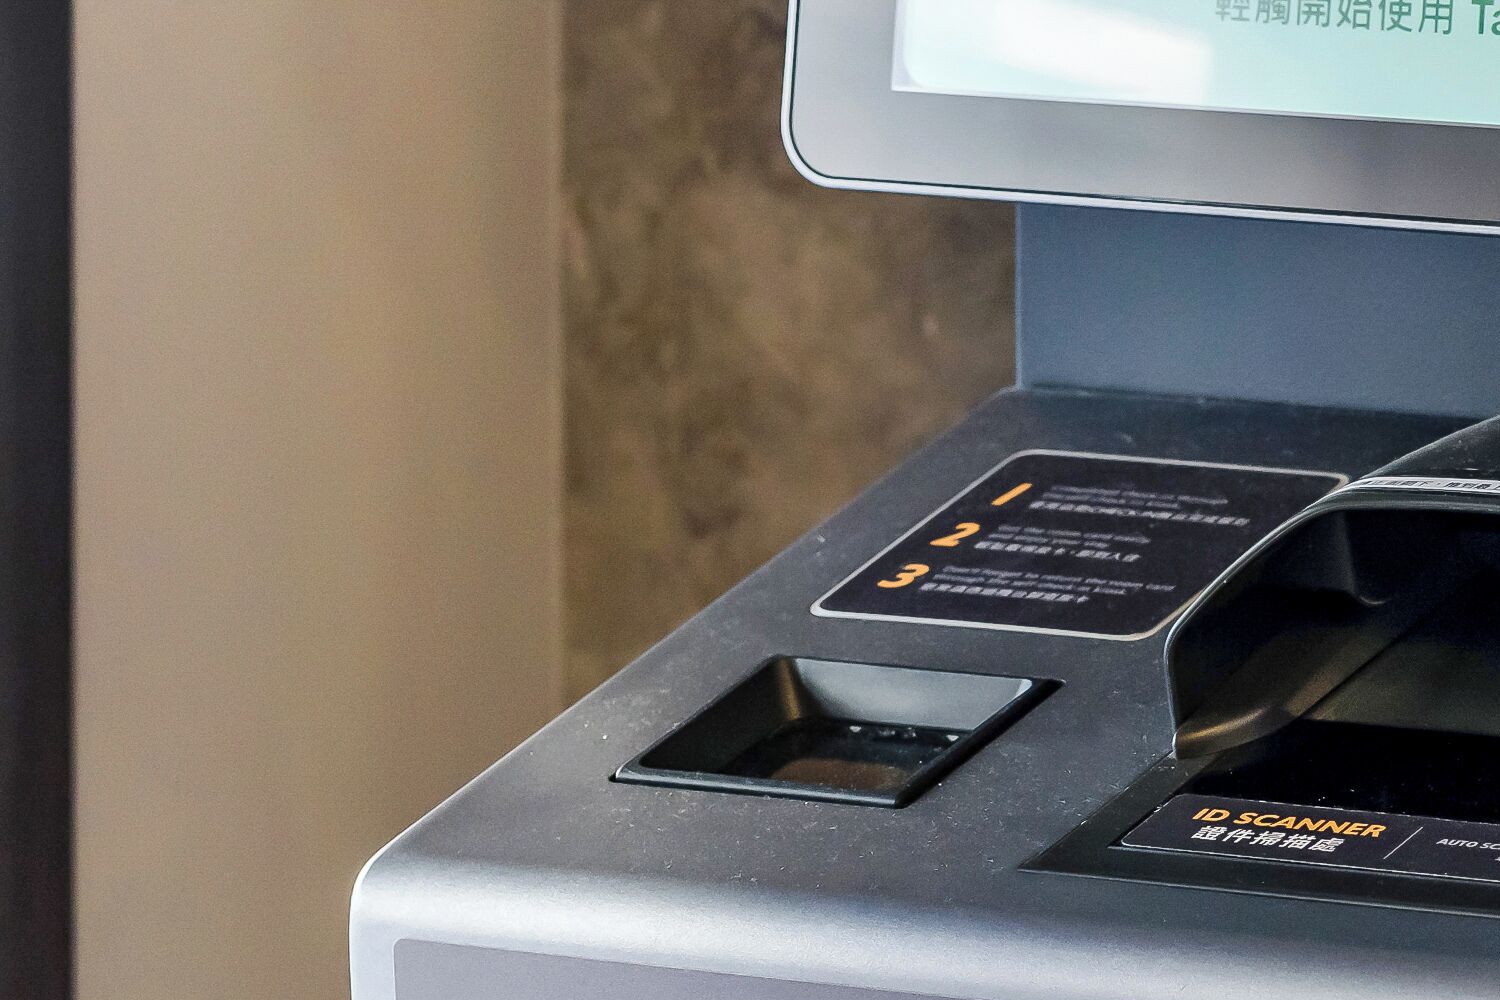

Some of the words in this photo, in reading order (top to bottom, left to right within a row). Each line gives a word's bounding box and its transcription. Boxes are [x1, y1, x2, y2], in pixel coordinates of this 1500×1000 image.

[990, 482, 1033, 507] 1
[928, 521, 982, 547] 2
[876, 563, 930, 589] 3
[1191, 807, 1231, 823] ID
[1233, 812, 1387, 839] SCANNER
[1190, 825, 1346, 853] 證件掃描處
[1436, 837, 1479, 849] AUTO
